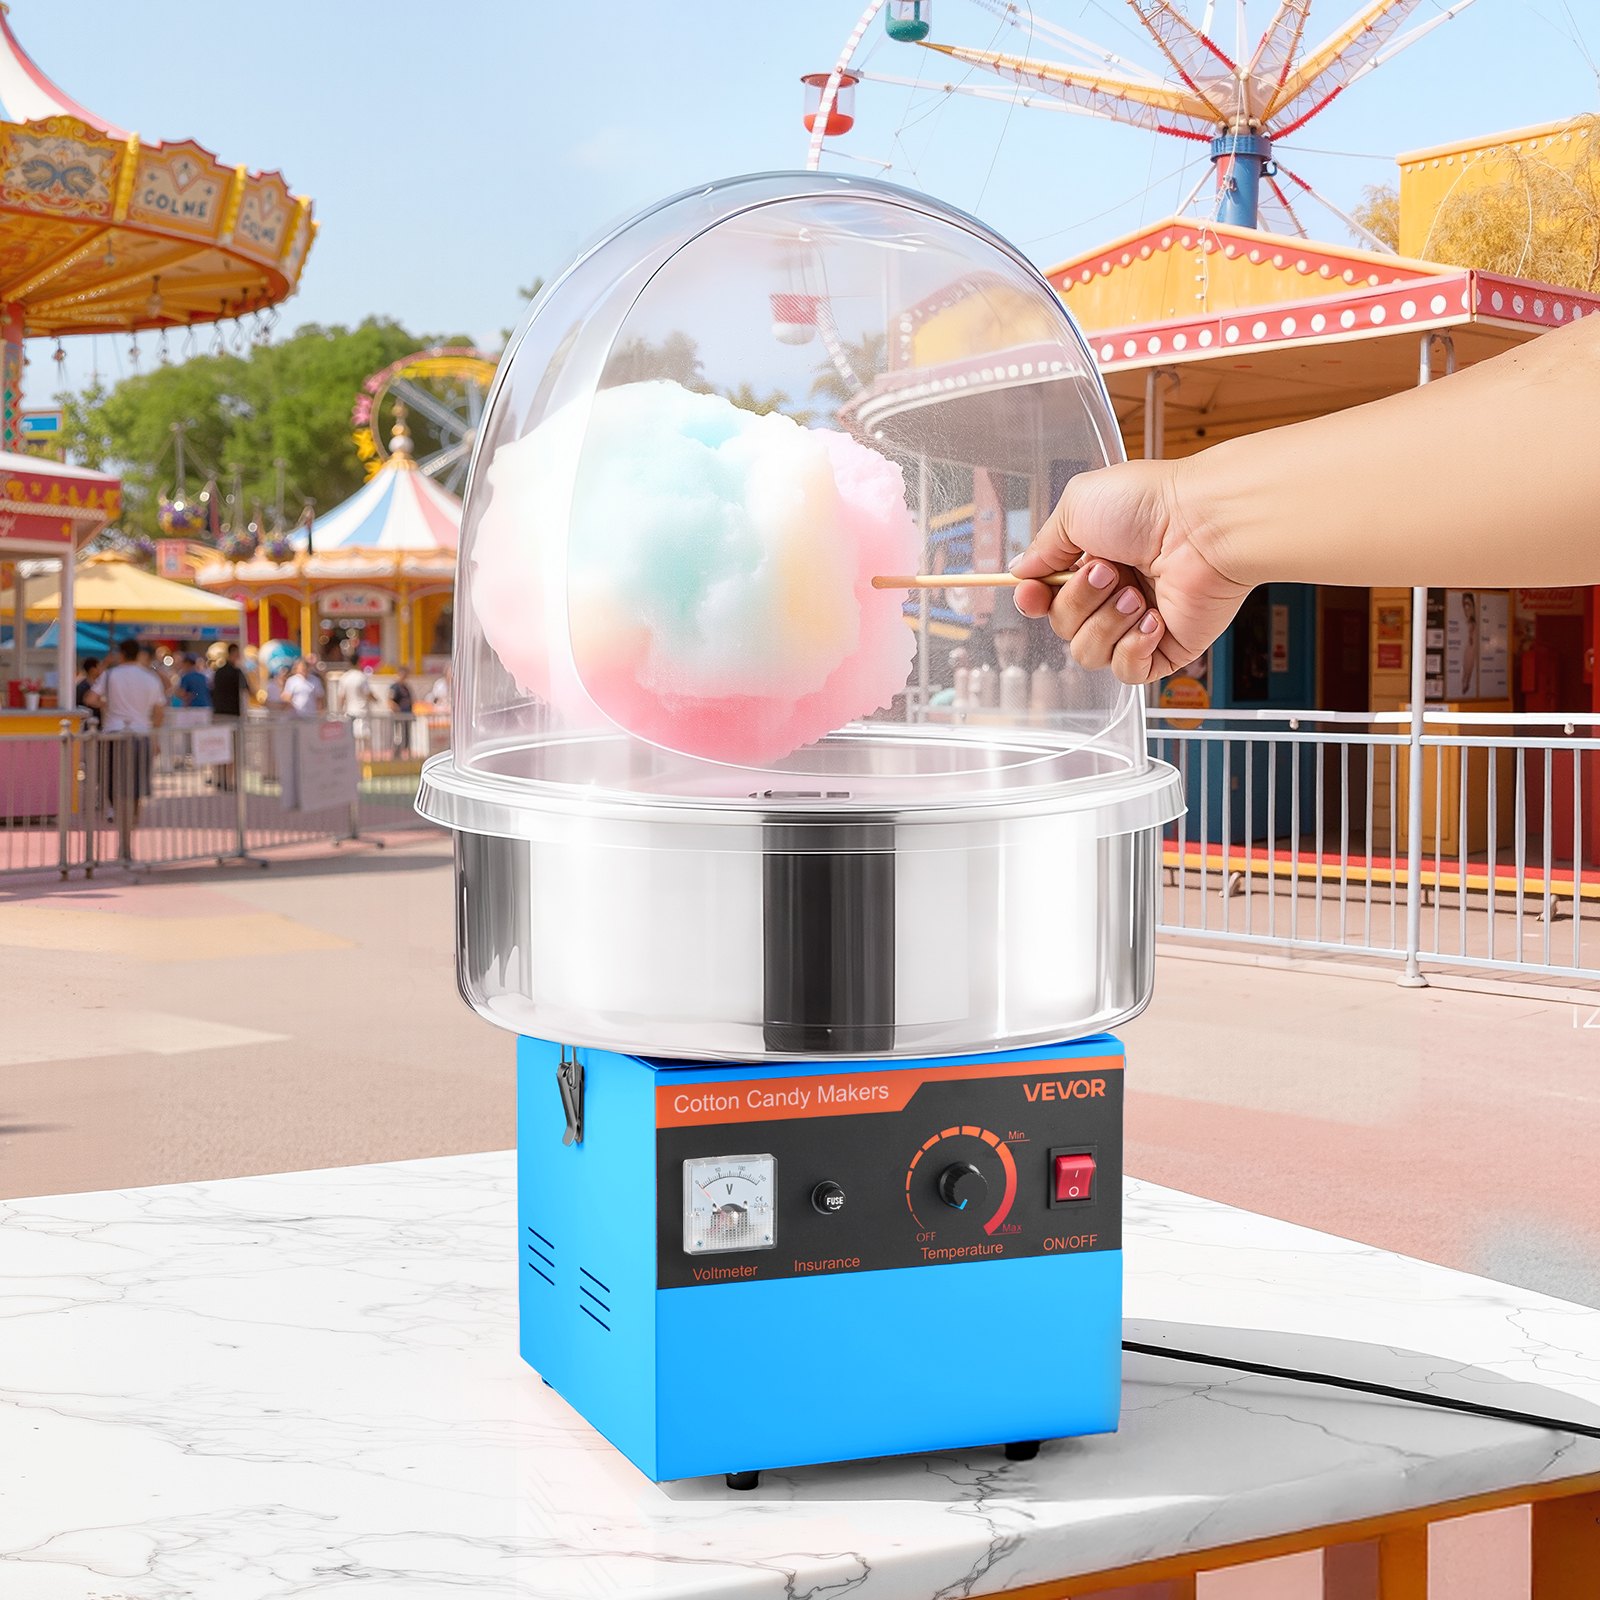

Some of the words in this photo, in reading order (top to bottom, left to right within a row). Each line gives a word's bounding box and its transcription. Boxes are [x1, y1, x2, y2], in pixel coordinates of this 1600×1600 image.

[673, 1094, 740, 1114] Cotton
[746, 1087, 811, 1110] Candy
[817, 1083, 890, 1104] Makers
[1023, 1078, 1107, 1103] VEVOR
[1008, 1130, 1025, 1140] Min
[725, 1183, 734, 1196] V
[826, 1195, 844, 1206] FUSE
[1002, 1223, 1023, 1233] Max
[915, 1231, 937, 1243] OFF
[1043, 1233, 1099, 1251] ON/OFF
[920, 1242, 1004, 1260] Temperature
[692, 1263, 759, 1281] Voltmeter
[793, 1256, 861, 1272] Insurance
